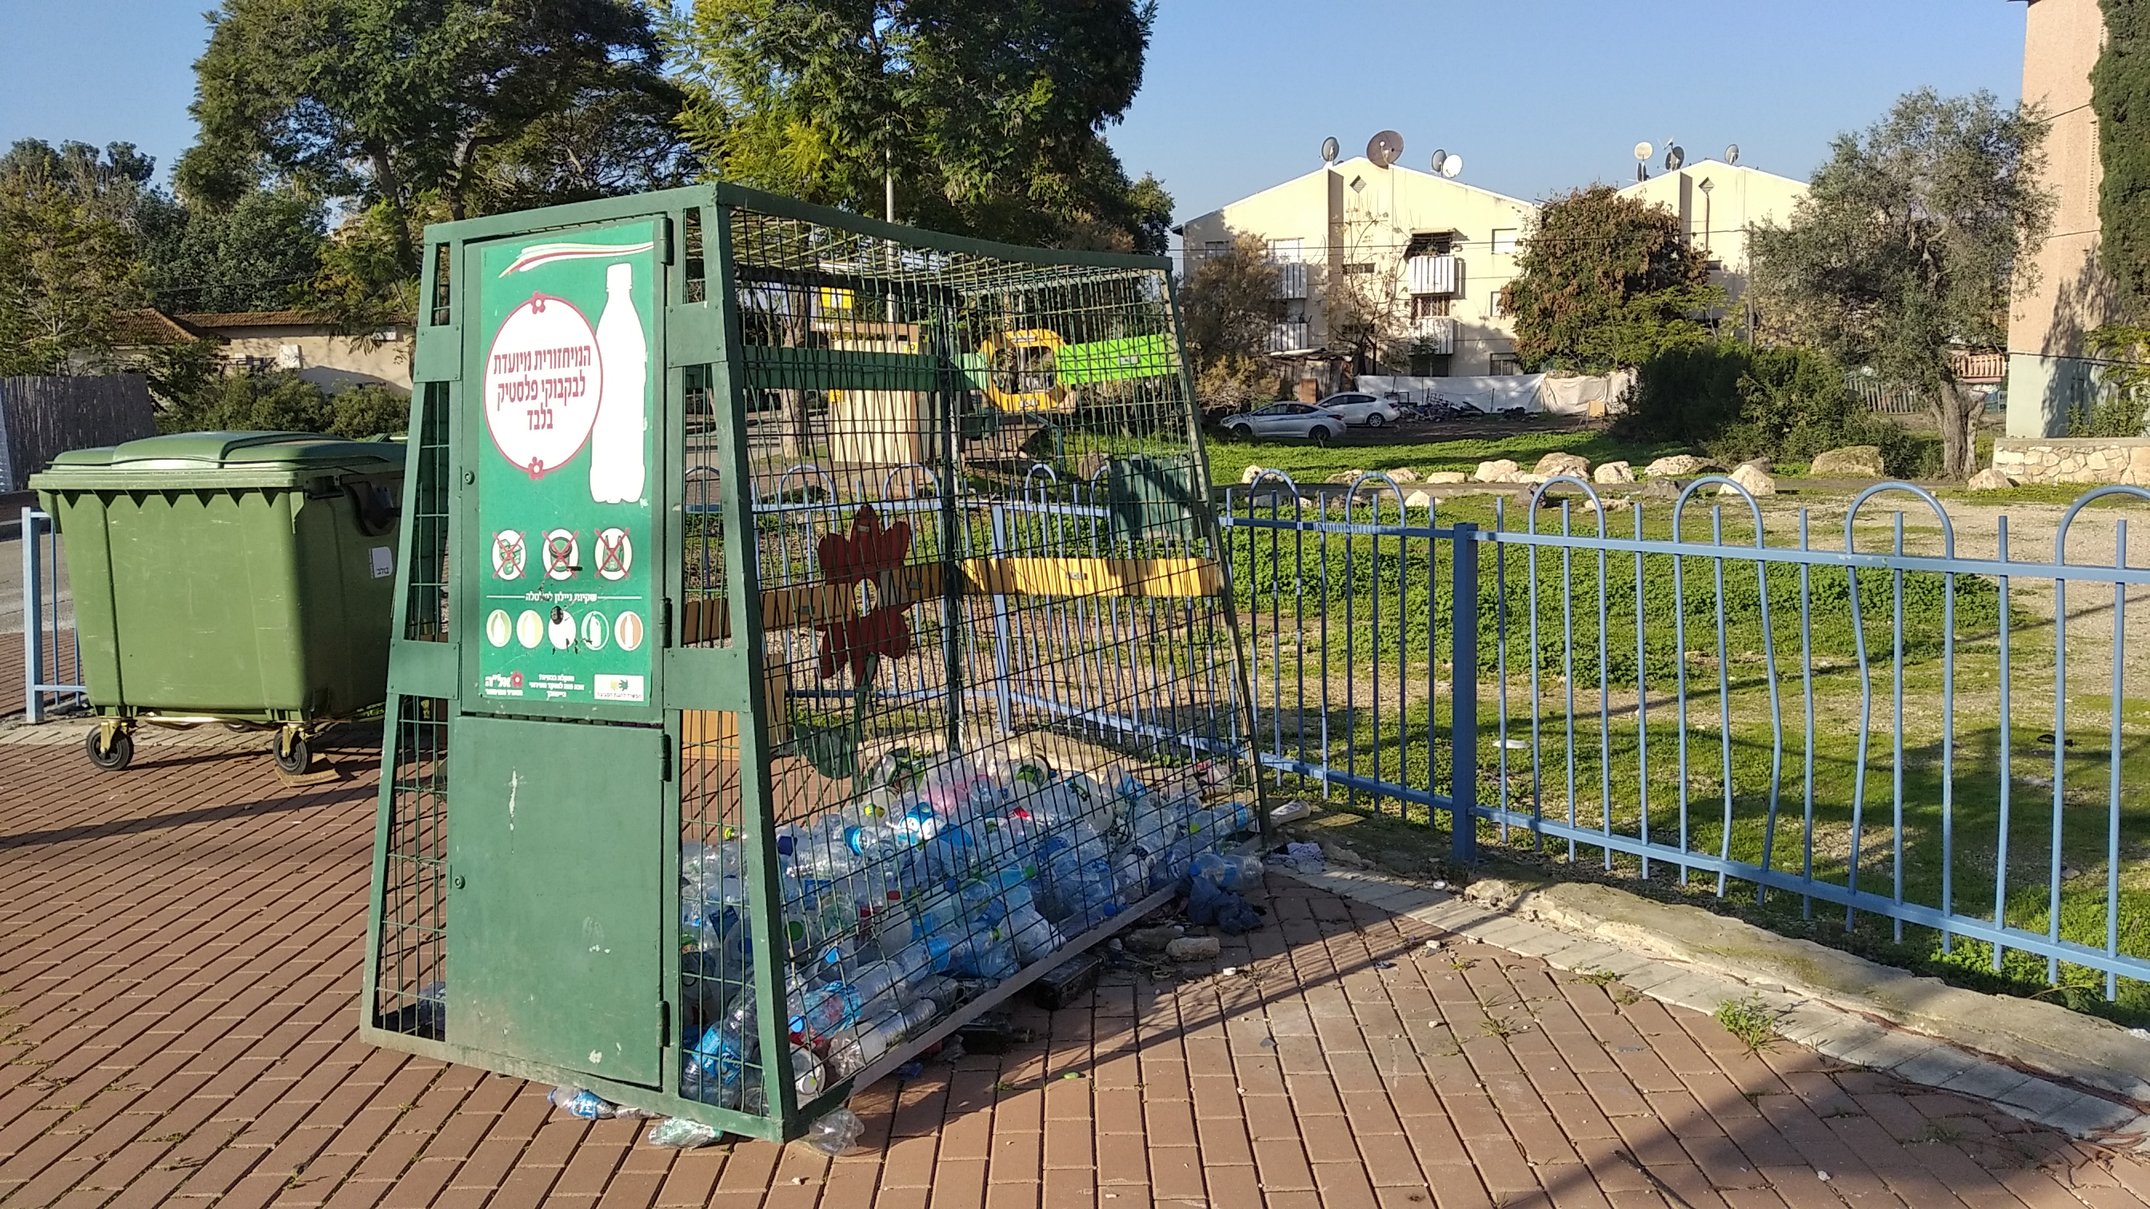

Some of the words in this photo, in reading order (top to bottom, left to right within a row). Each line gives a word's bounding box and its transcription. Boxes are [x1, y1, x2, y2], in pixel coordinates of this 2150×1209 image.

[494, 351, 531, 374] מיועדת
[534, 345, 590, 370] המיחזורית
[497, 374, 538, 411] פלסטיק
[541, 369, 585, 407] לבקבוקי
[527, 402, 553, 430] בלבד
